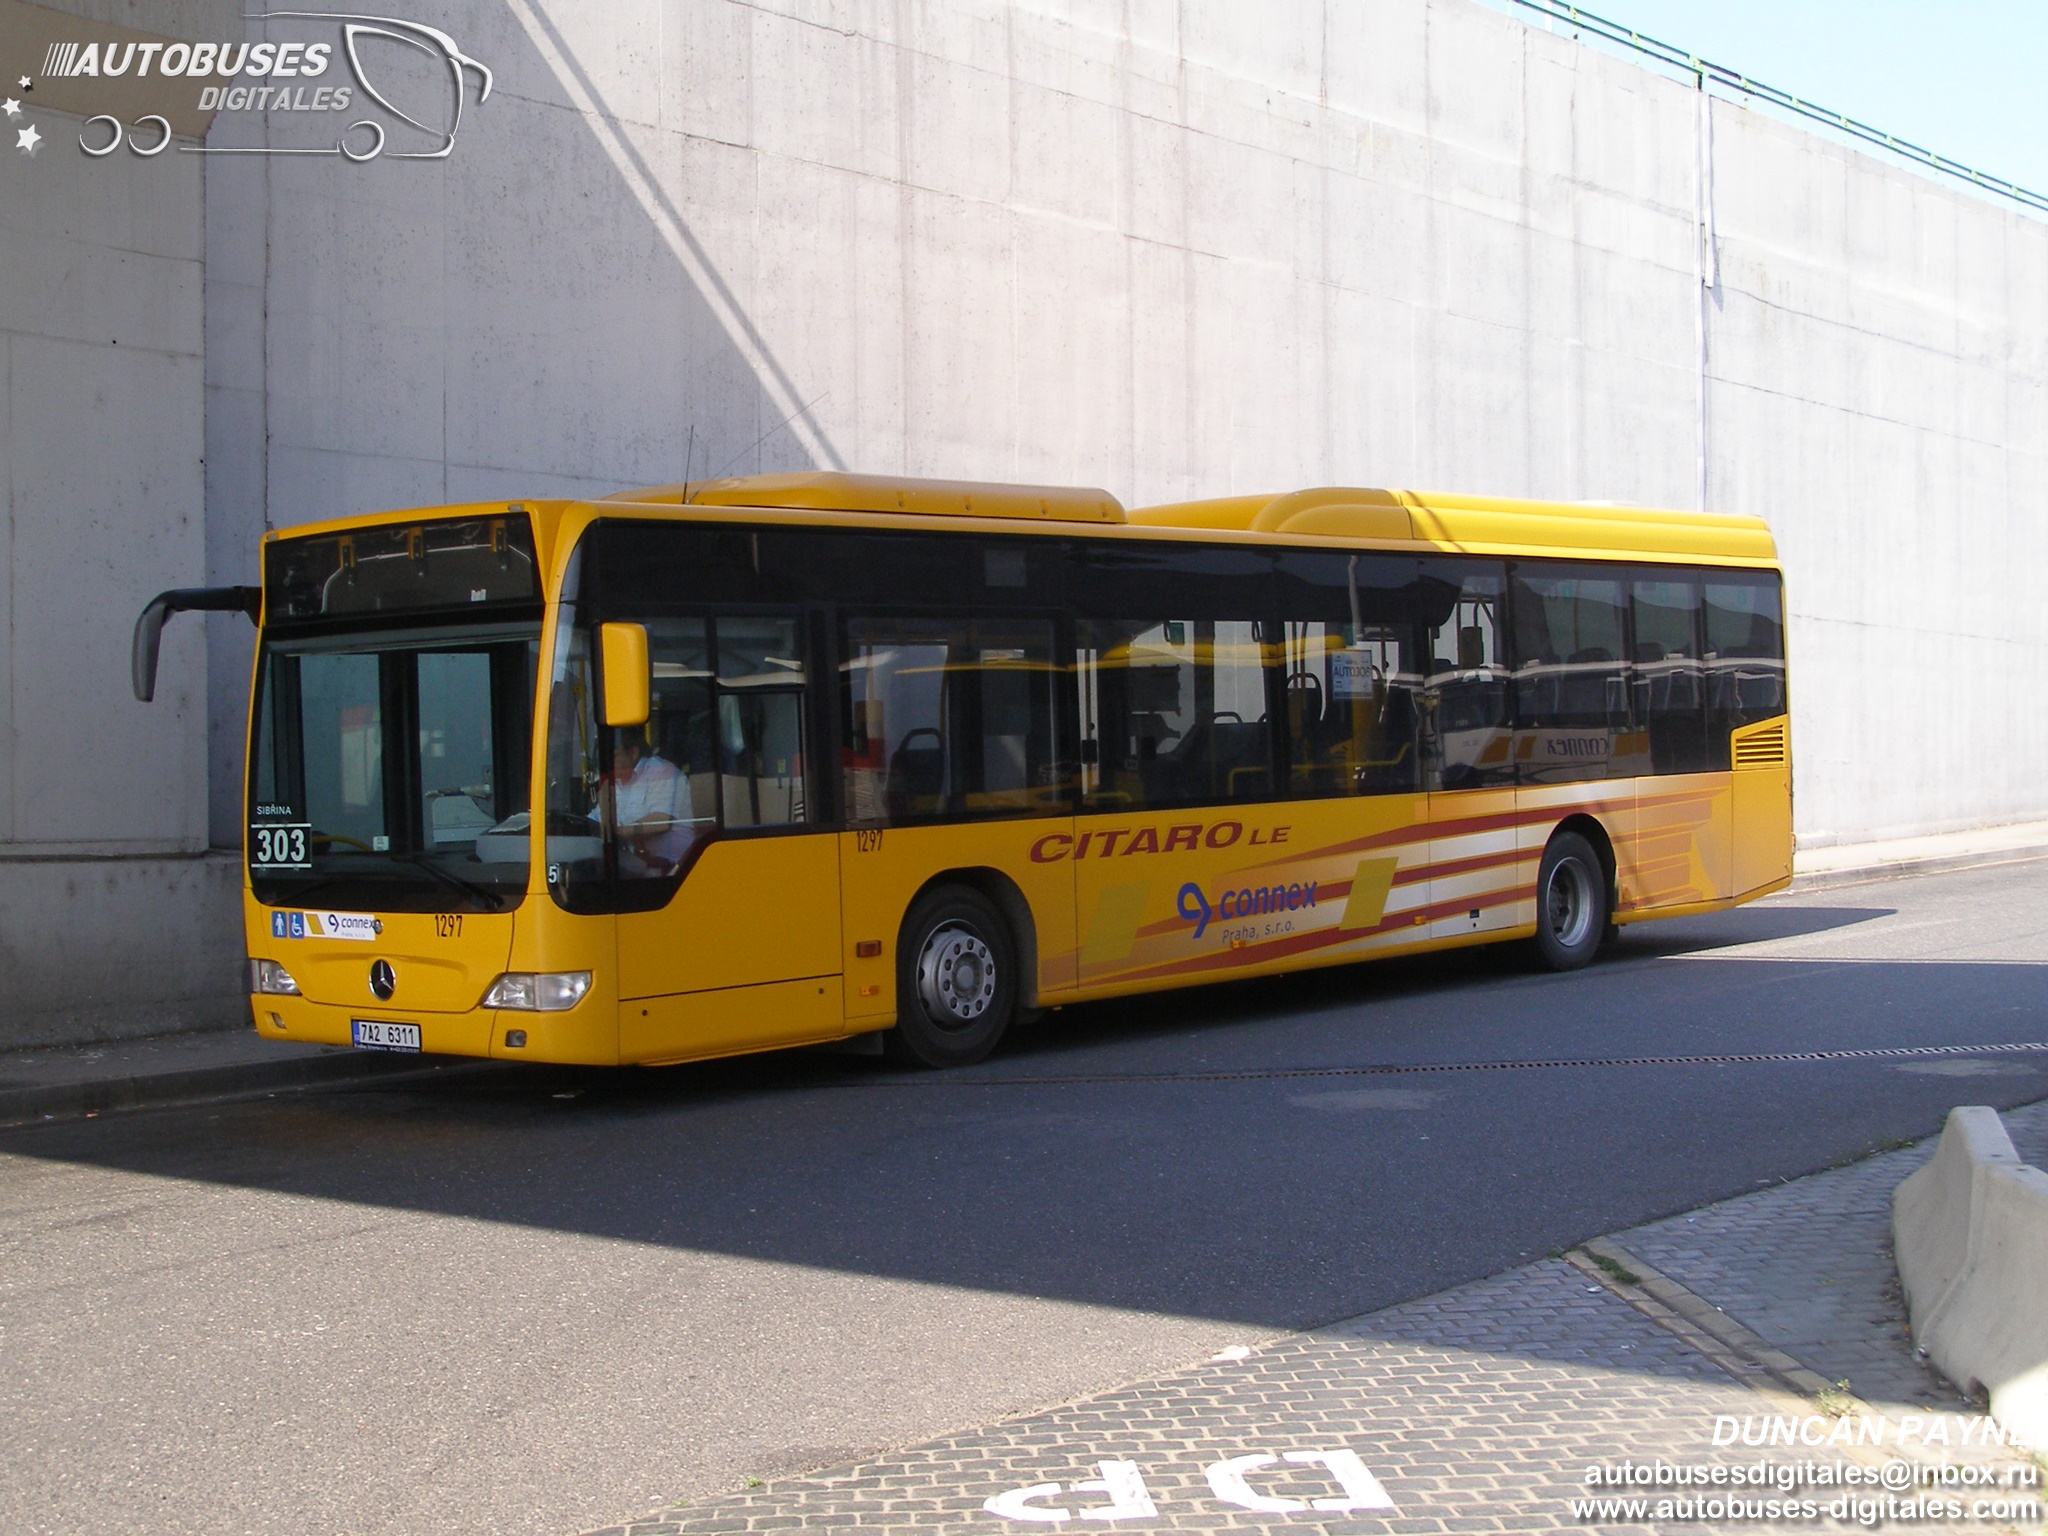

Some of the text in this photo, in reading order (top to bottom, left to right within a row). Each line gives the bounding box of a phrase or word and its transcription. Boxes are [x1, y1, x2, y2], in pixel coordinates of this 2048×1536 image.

[256, 803, 292, 815] SIBŘINA
[257, 829, 306, 862] 303
[856, 830, 884, 852] 1297
[1029, 821, 1291, 864] CITARO LE
[1218, 880, 1318, 921] connex
[434, 914, 463, 938] 1297
[1222, 920, 1295, 944] Praha, s.r.o.
[361, 1024, 414, 1045] 7A2 6311
